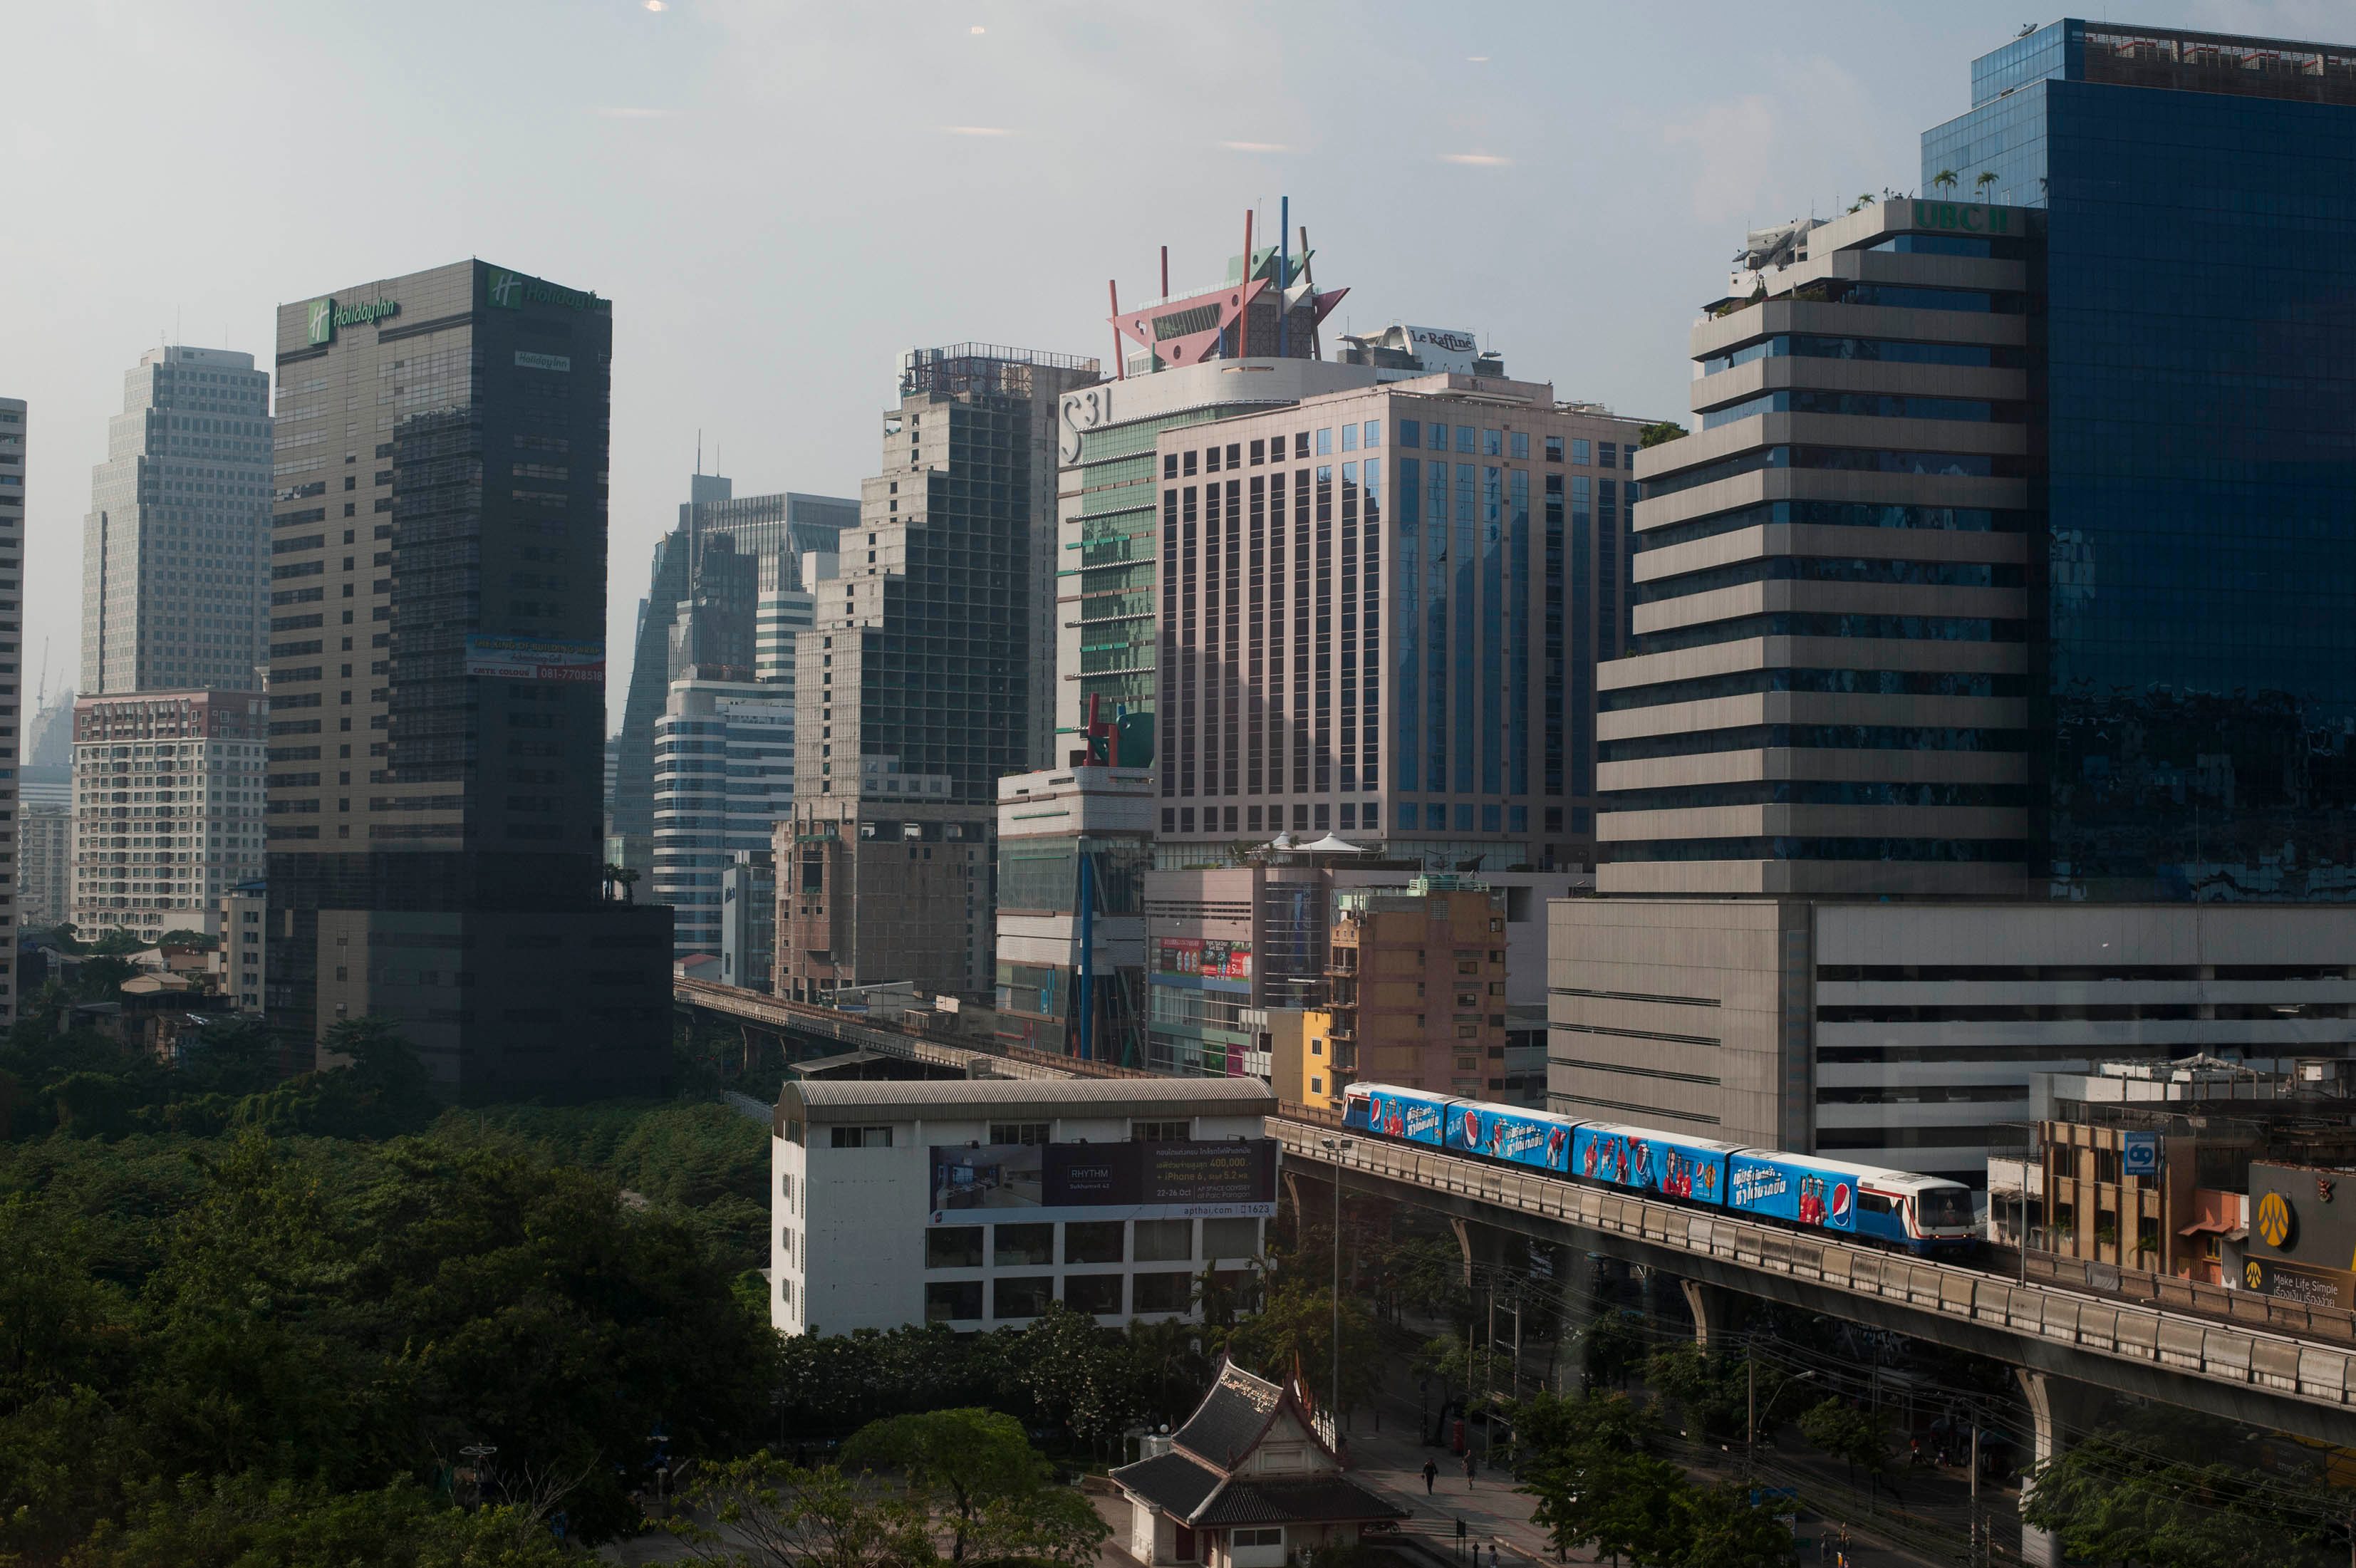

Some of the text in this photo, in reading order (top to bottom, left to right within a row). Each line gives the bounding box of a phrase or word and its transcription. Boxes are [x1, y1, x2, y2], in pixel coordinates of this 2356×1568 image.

[1914, 202, 1984, 232] UBC
[526, 282, 611, 312] Holiday Inn
[333, 296, 396, 328] Holiday Inn
[1410, 330, 1426, 343] Le
[519, 353, 568, 368] Holiday Inn
[519, 641, 529, 650] OF
[532, 641, 574, 653] BUILDING
[499, 668, 530, 677] COLOUR
[1071, 1169, 1109, 1178] RHYTHM
[1164, 1172, 1195, 1180] iPhone
[1224, 1170, 1237, 1180] 5.2
[1178, 1188, 1192, 1196] Oct
[1184, 1205, 1270, 1215] apthai.com 1623
[2273, 1272, 2338, 1295] Make Life Simple
